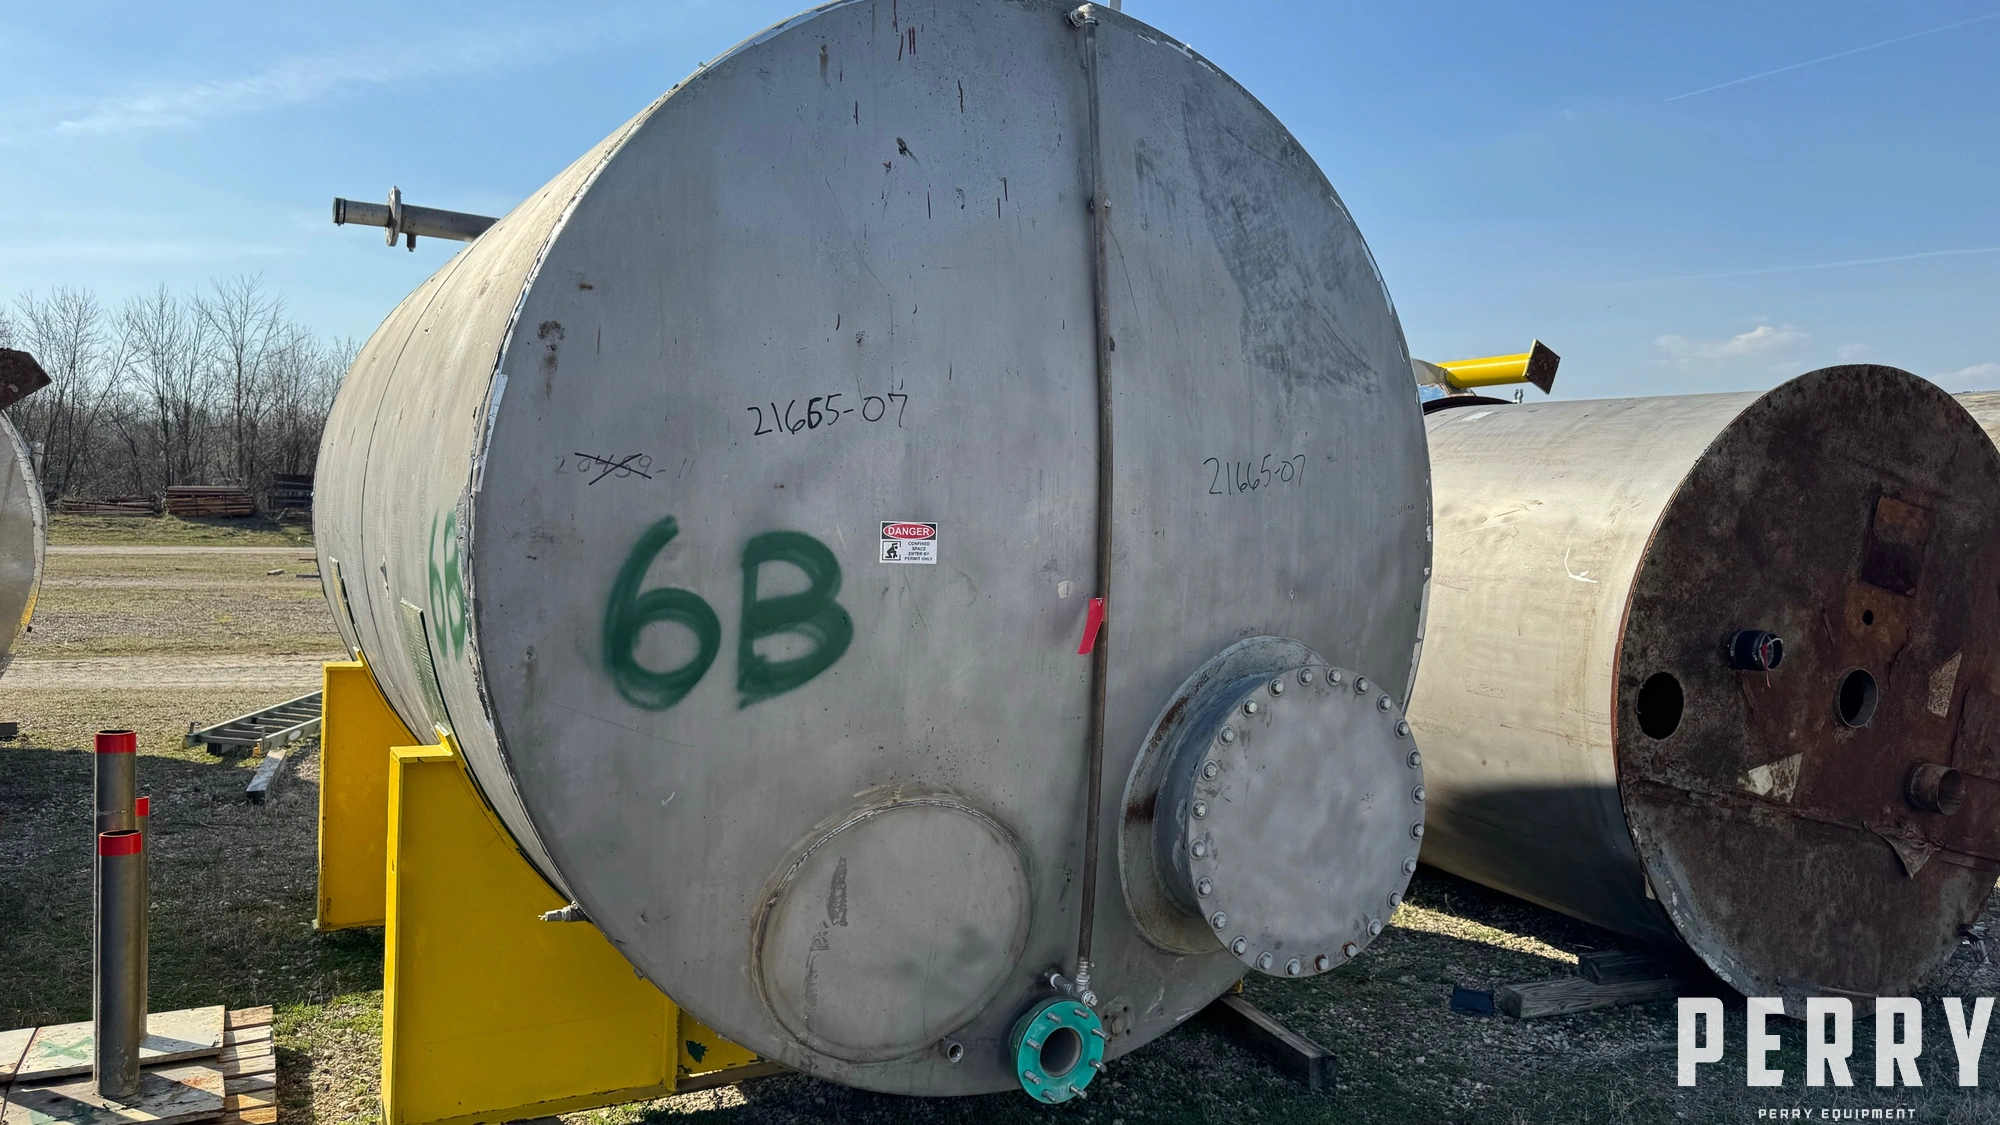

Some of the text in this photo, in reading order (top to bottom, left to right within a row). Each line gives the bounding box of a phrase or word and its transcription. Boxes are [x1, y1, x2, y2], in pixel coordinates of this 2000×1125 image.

[1203, 453, 1306, 495] 21665-07
[887, 527, 930, 536] DANGER
[604, 514, 854, 713] 6B
